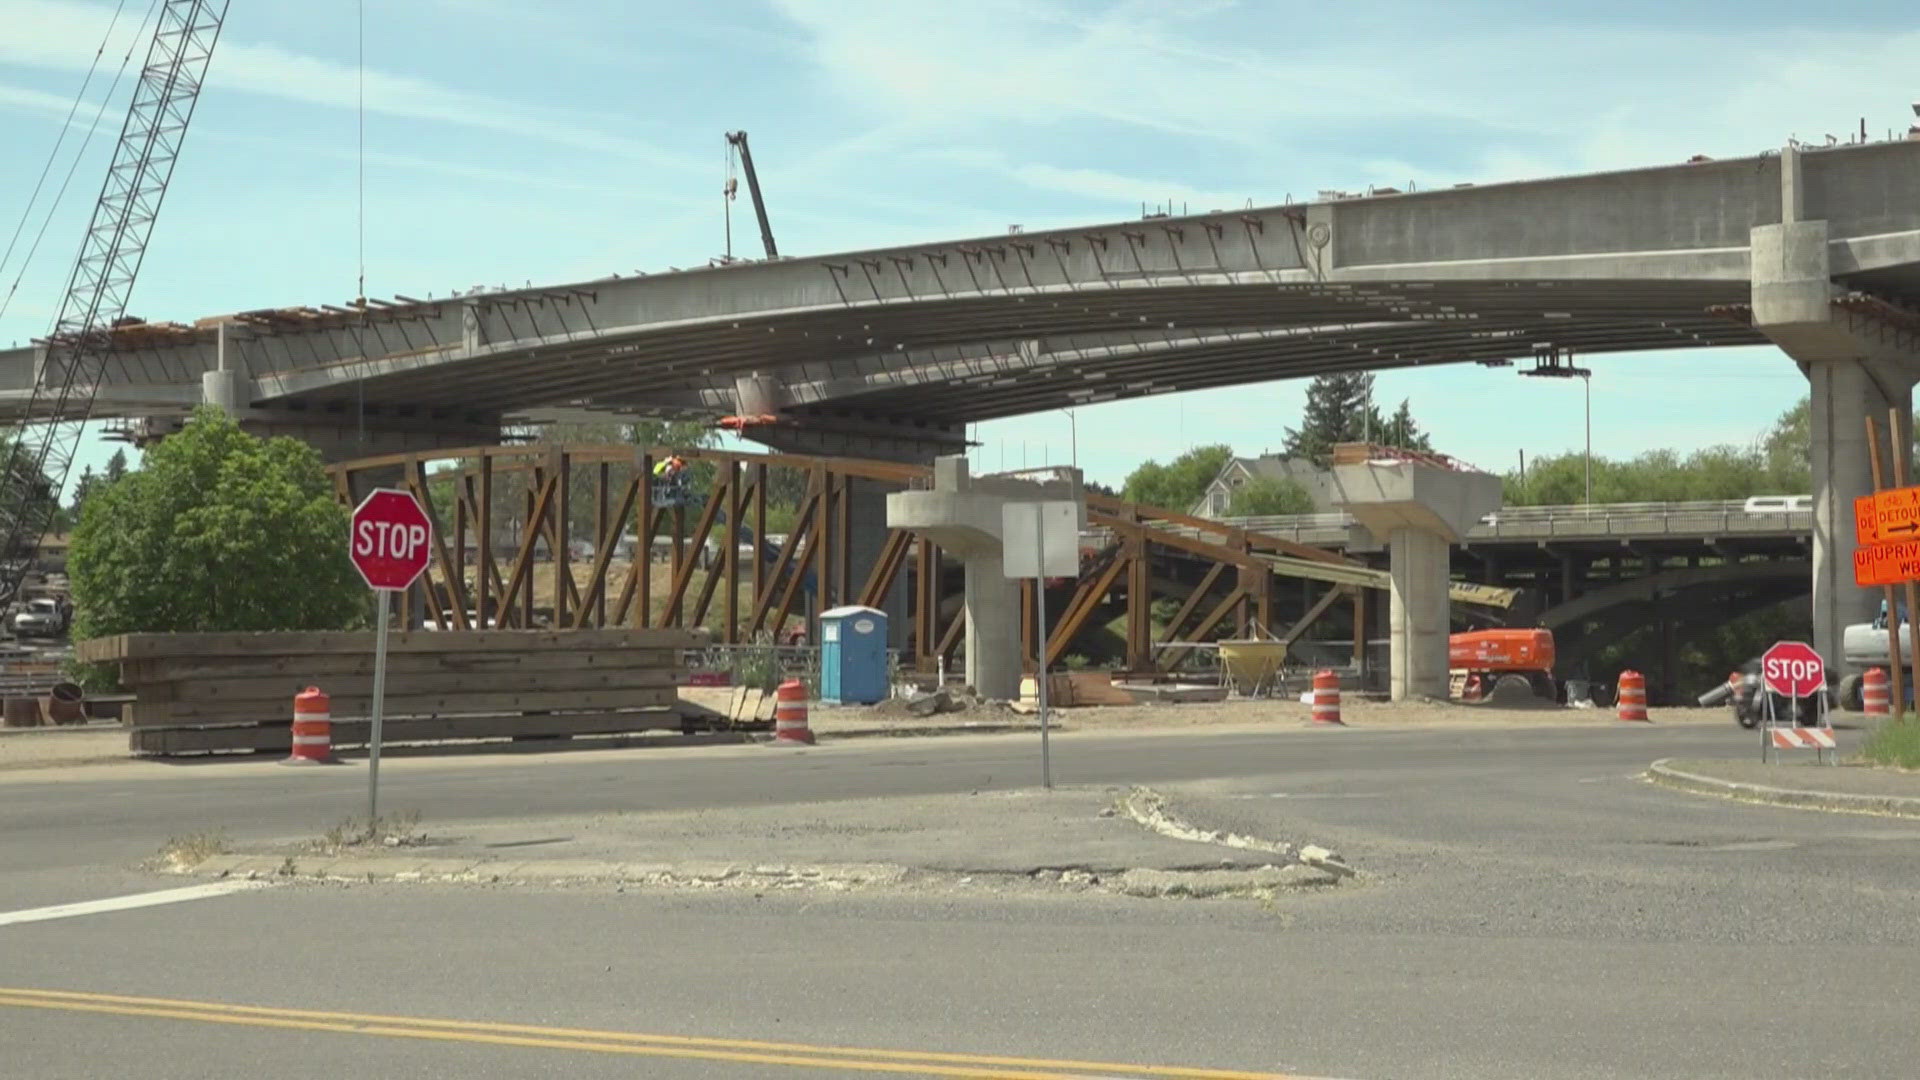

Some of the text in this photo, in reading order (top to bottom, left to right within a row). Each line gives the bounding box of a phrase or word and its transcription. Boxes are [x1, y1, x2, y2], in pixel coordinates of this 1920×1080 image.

[1879, 506, 1920, 523] DETOU
[357, 520, 426, 560] STOP
[1767, 658, 1820, 681] STOP
